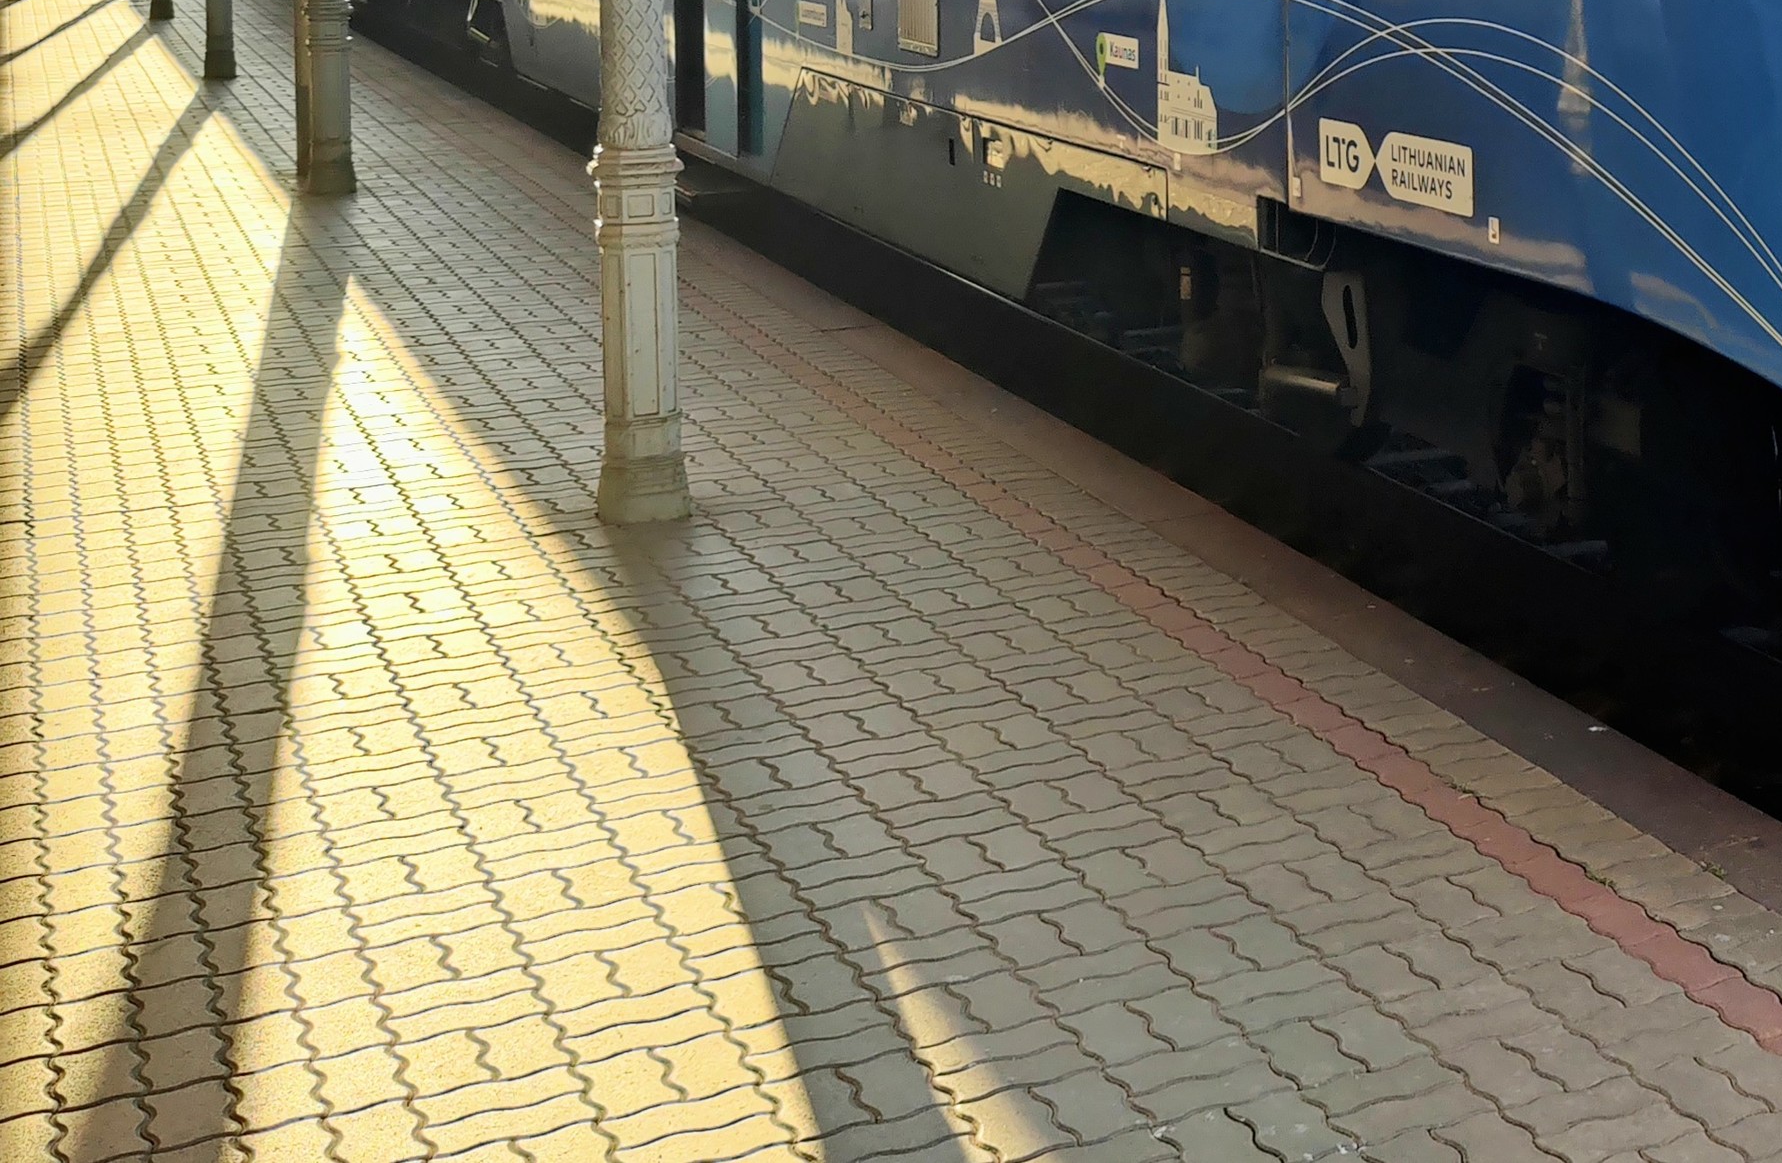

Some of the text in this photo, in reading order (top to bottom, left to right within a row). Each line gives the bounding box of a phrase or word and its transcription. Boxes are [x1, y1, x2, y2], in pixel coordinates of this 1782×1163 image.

[1108, 40, 1137, 63] Kaunas
[1325, 134, 1361, 174] LTG
[1390, 143, 1467, 178] LITHUANIAN
[1390, 168, 1453, 201] RAILWAYS
